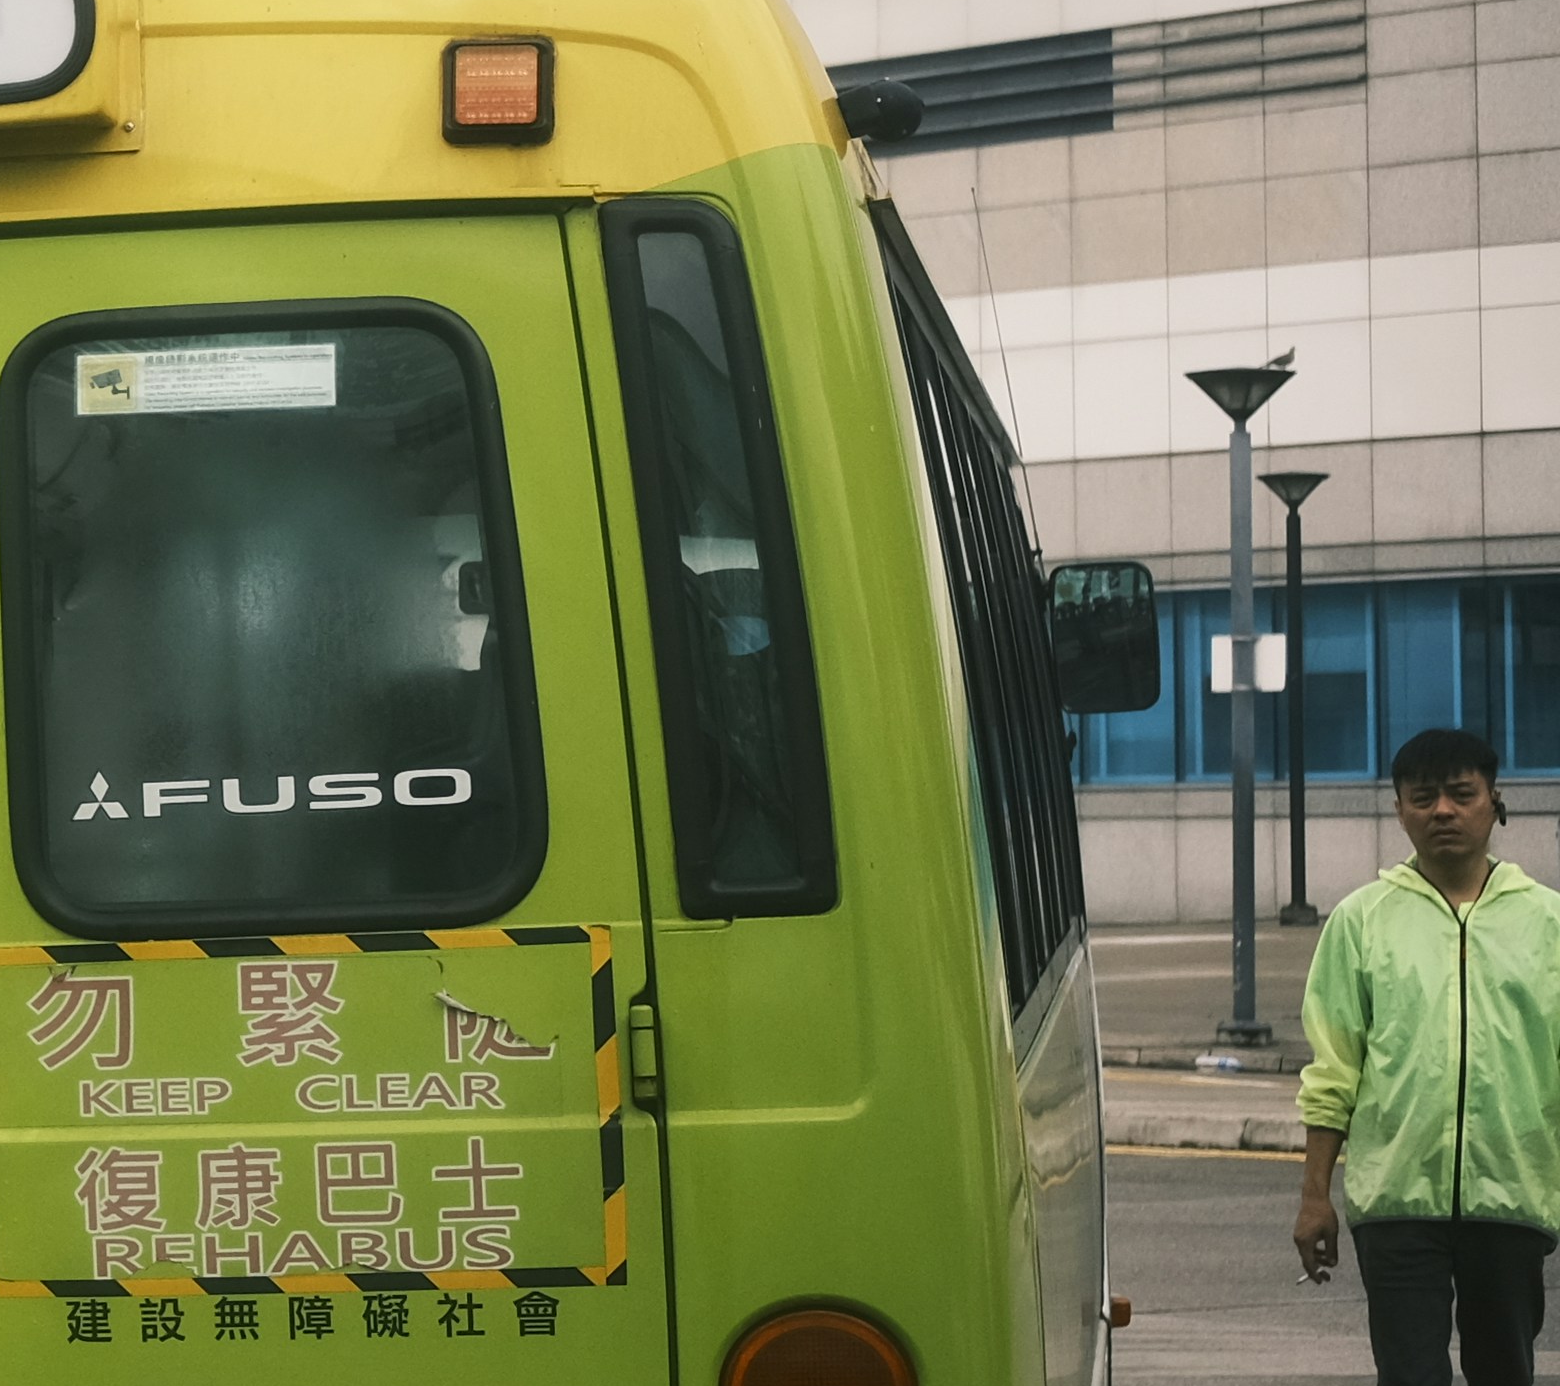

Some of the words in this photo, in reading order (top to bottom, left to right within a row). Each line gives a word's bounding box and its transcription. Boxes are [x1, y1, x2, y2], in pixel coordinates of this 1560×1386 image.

[142, 768, 472, 818] FUSO
[78, 1077, 232, 1117] KEEP
[295, 1072, 506, 1112] CLEAR
[74, 1135, 525, 1234] 復康巴士
[90, 1225, 516, 1279] REHABUS
[65, 1290, 561, 1344] 建設無障礙社會
